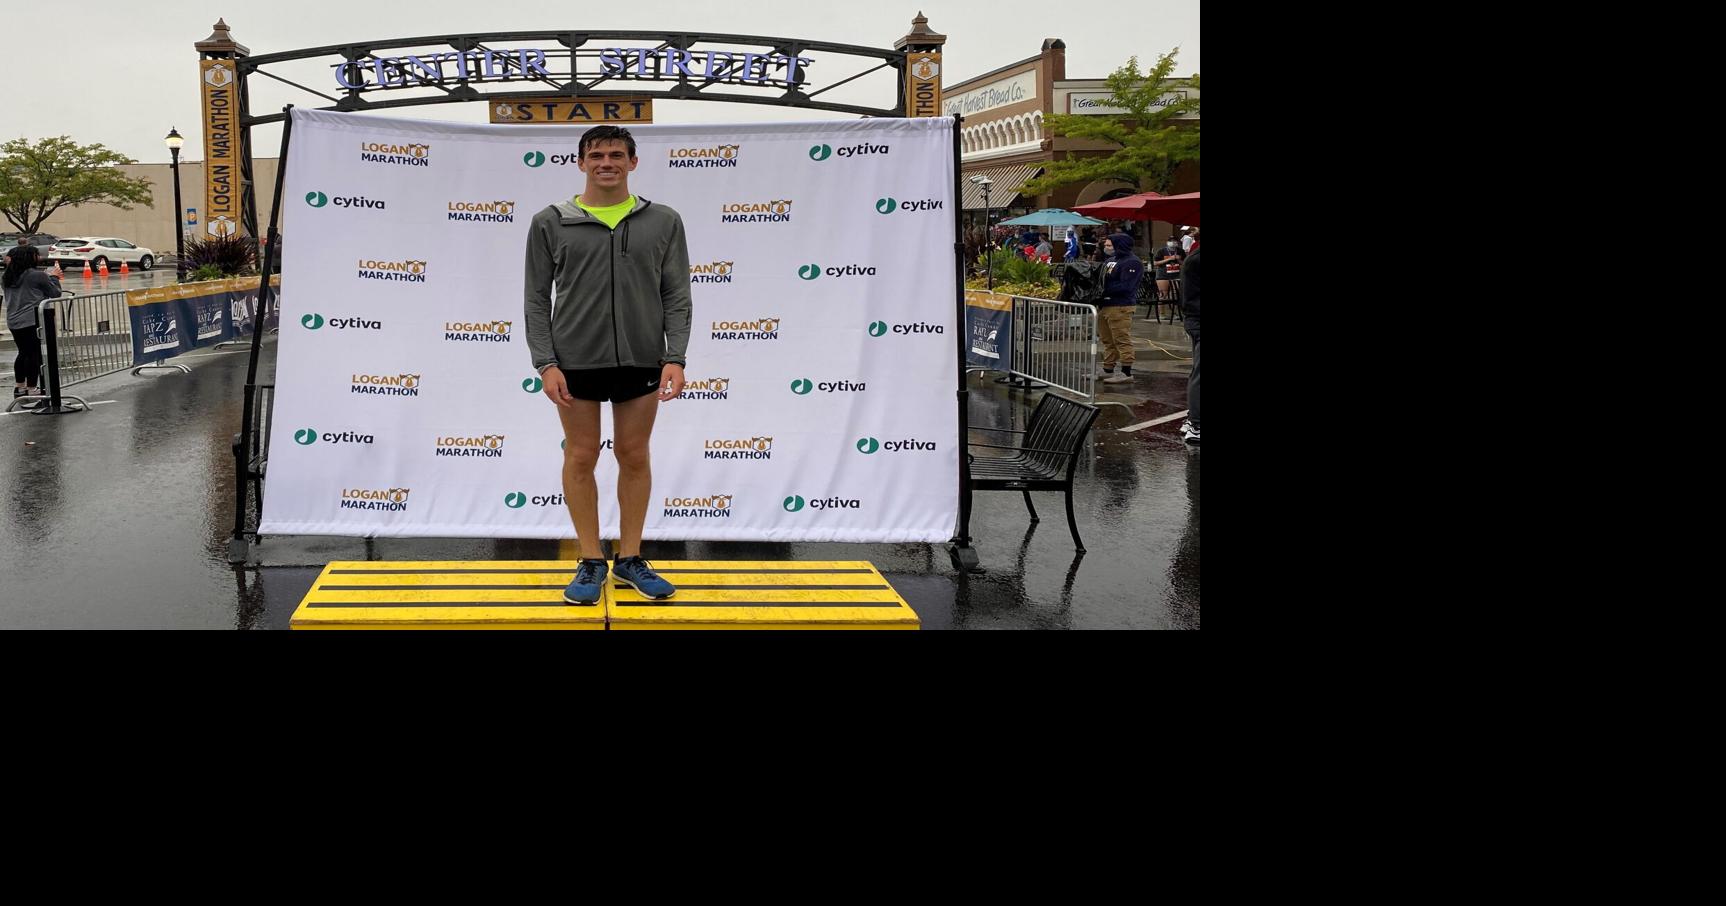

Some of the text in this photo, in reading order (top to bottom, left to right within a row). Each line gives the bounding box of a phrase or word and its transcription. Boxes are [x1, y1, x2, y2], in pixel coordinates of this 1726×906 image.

[336, 47, 810, 89] CENTER STREET
[916, 82, 934, 116] THON
[988, 85, 1011, 108] Bread
[1078, 98, 1100, 108] Grea
[517, 102, 646, 121] START
[211, 89, 230, 213] LOGAN MARATHON
[361, 142, 409, 155] LOGAN
[670, 148, 718, 158] LOGAN
[837, 142, 889, 157] cytiva
[361, 152, 429, 167] MARATHON
[550, 153, 577, 165] cyt
[668, 158, 737, 168] MARATHON
[333, 196, 385, 210] cytiva
[448, 202, 495, 212] LOGAN
[722, 203, 771, 214] LOGAN
[448, 212, 514, 223] MARATHON
[721, 213, 790, 223] MARATHON
[359, 259, 406, 272] LOGAN
[689, 264, 713, 273] GAN
[826, 264, 877, 278] cytiva
[358, 270, 426, 283] MARATHON
[691, 275, 732, 283] ATHON
[329, 317, 382, 330] cytiva
[446, 322, 492, 333] LOGAN
[711, 321, 759, 331] LOGAN
[892, 322, 944, 335] cytiva
[445, 332, 511, 342] MARATHON
[711, 331, 778, 340] MARATHON
[351, 374, 400, 386] LOGAN
[818, 379, 866, 392] cytiva
[350, 385, 419, 397] MARATHON
[676, 391, 728, 400] RATHON
[322, 430, 374, 444] cytiva
[436, 436, 484, 447] LOGAN
[704, 439, 752, 449] LOGAN
[884, 438, 936, 452] cytiva
[436, 447, 503, 458] MARATHON
[704, 449, 771, 460] MARATHON
[342, 488, 389, 501] LOGAN
[531, 494, 567, 507] cyti
[340, 499, 407, 512] MARATHON
[664, 497, 712, 507] LOGAN
[810, 496, 860, 510] cytiva
[663, 508, 730, 518] MARATHON
